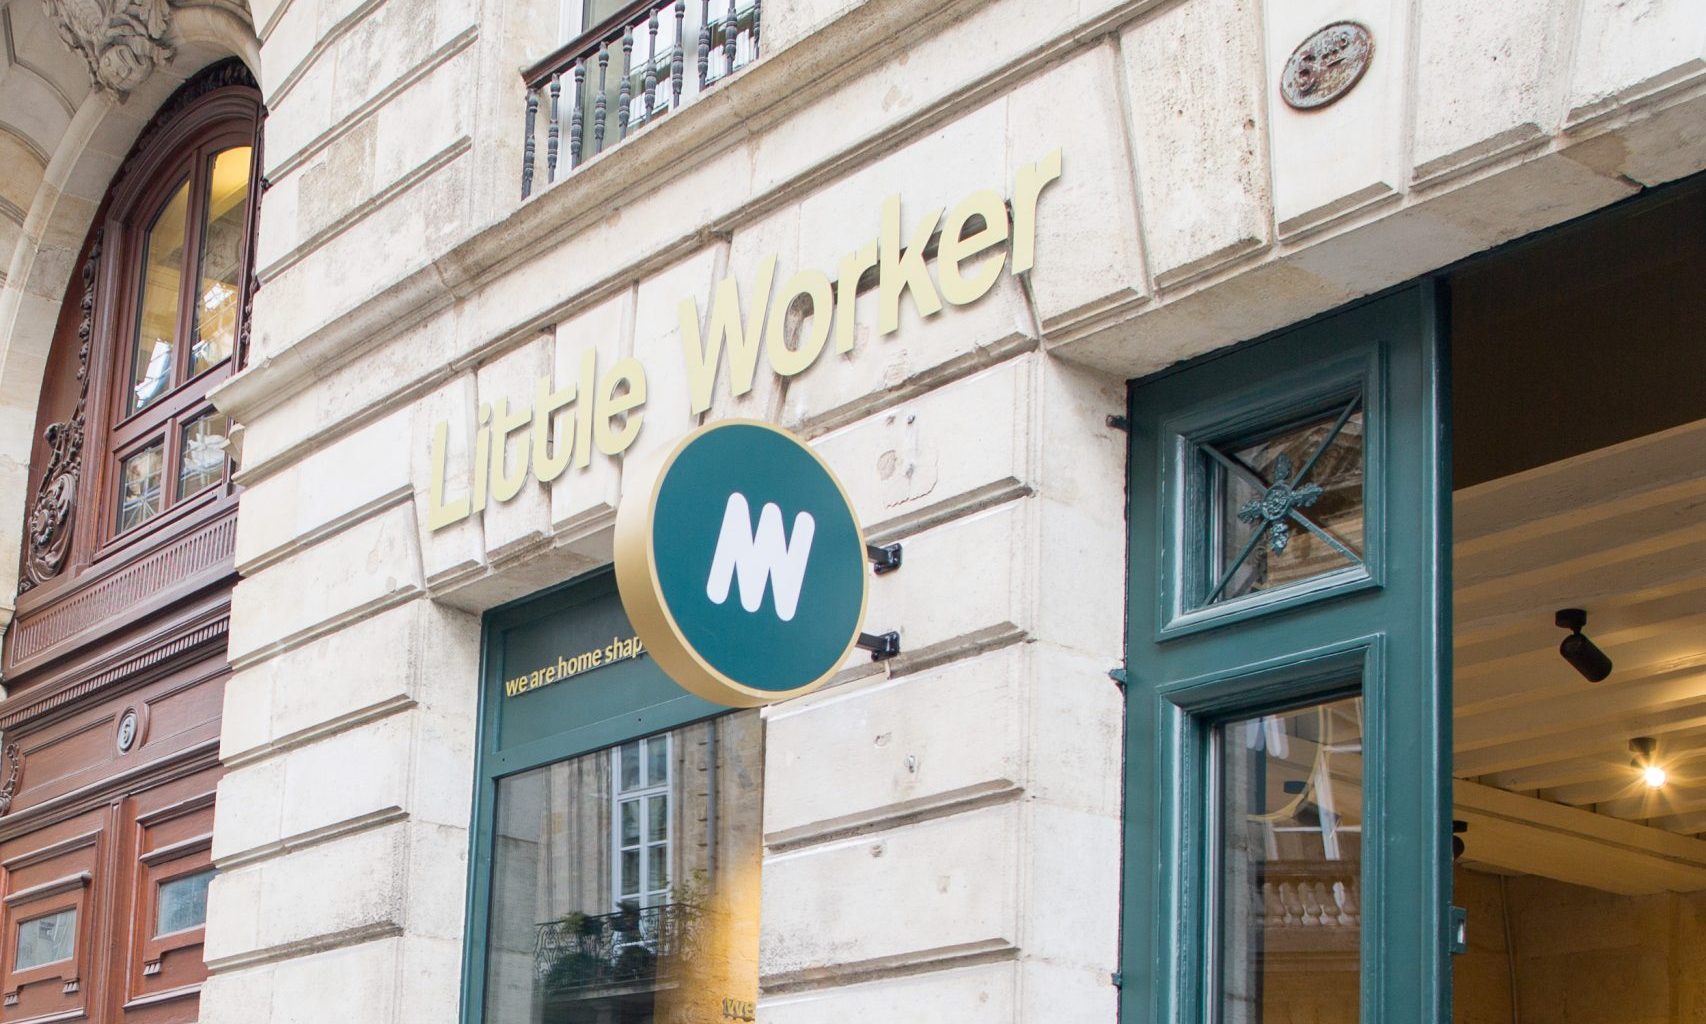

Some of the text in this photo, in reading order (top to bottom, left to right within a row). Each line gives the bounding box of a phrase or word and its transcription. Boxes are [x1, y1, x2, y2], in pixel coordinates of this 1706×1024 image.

[427, 147, 1062, 532] Little Worker
[505, 676, 528, 697] we
[530, 666, 555, 688] are
[557, 649, 602, 679] home
